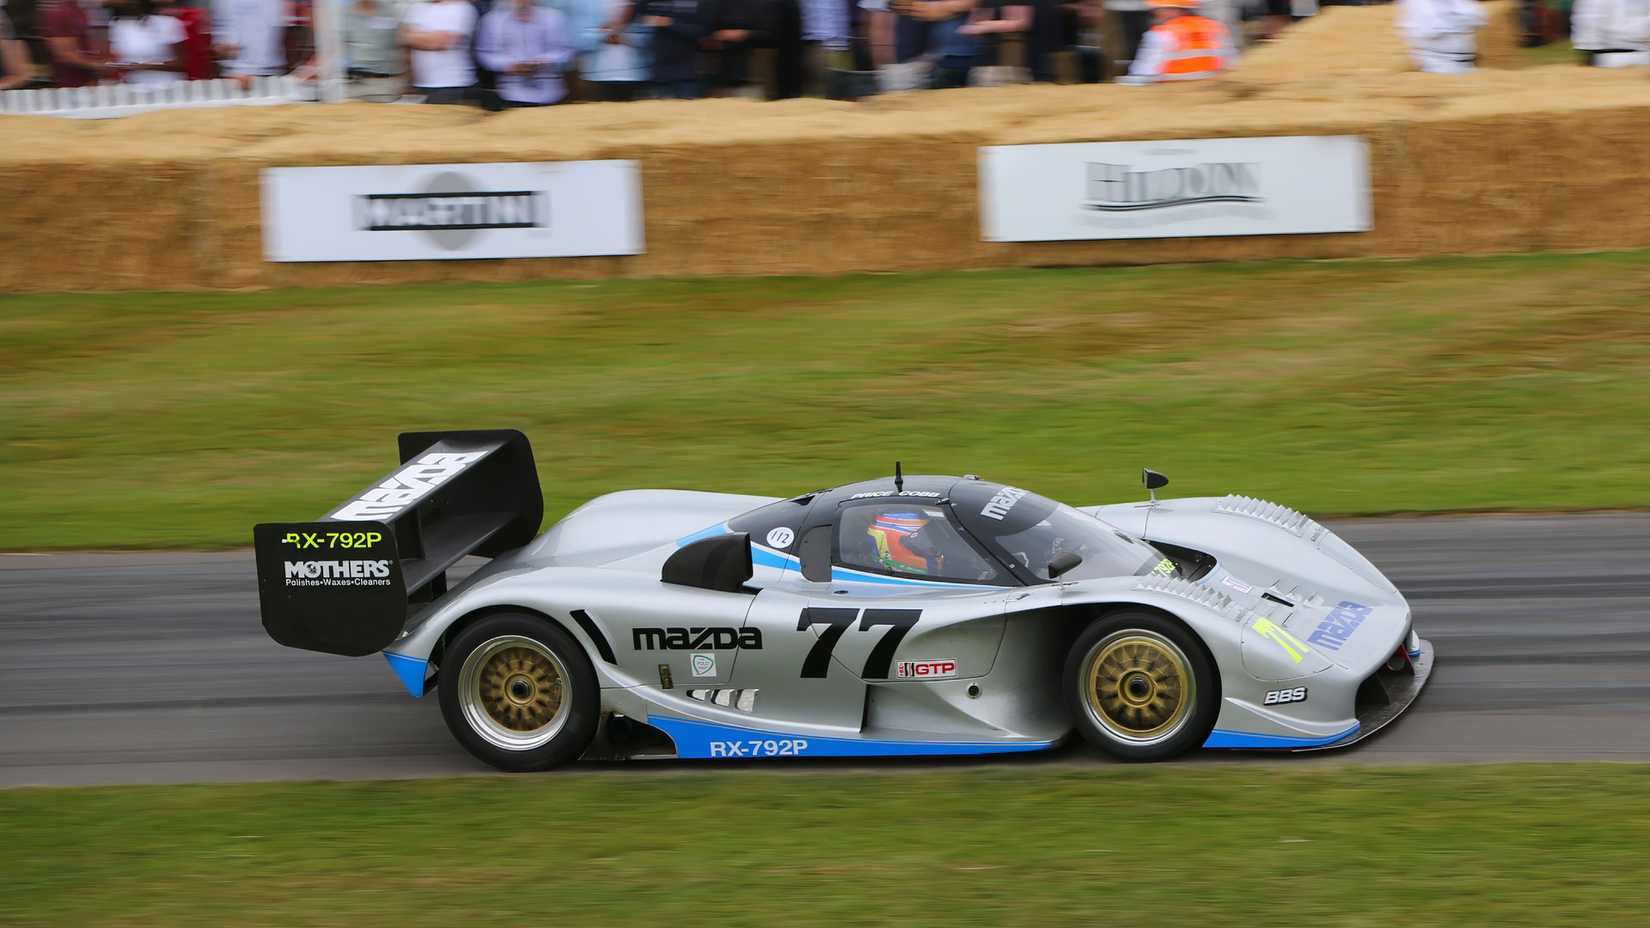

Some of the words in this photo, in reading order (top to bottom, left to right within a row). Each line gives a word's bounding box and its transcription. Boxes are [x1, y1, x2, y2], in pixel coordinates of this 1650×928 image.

[284, 560, 390, 578] MOTHERS
[797, 608, 923, 679] 77
[915, 662, 955, 676] GTP
[1264, 686, 1307, 705] BBS
[709, 739, 808, 758] RX-792P
